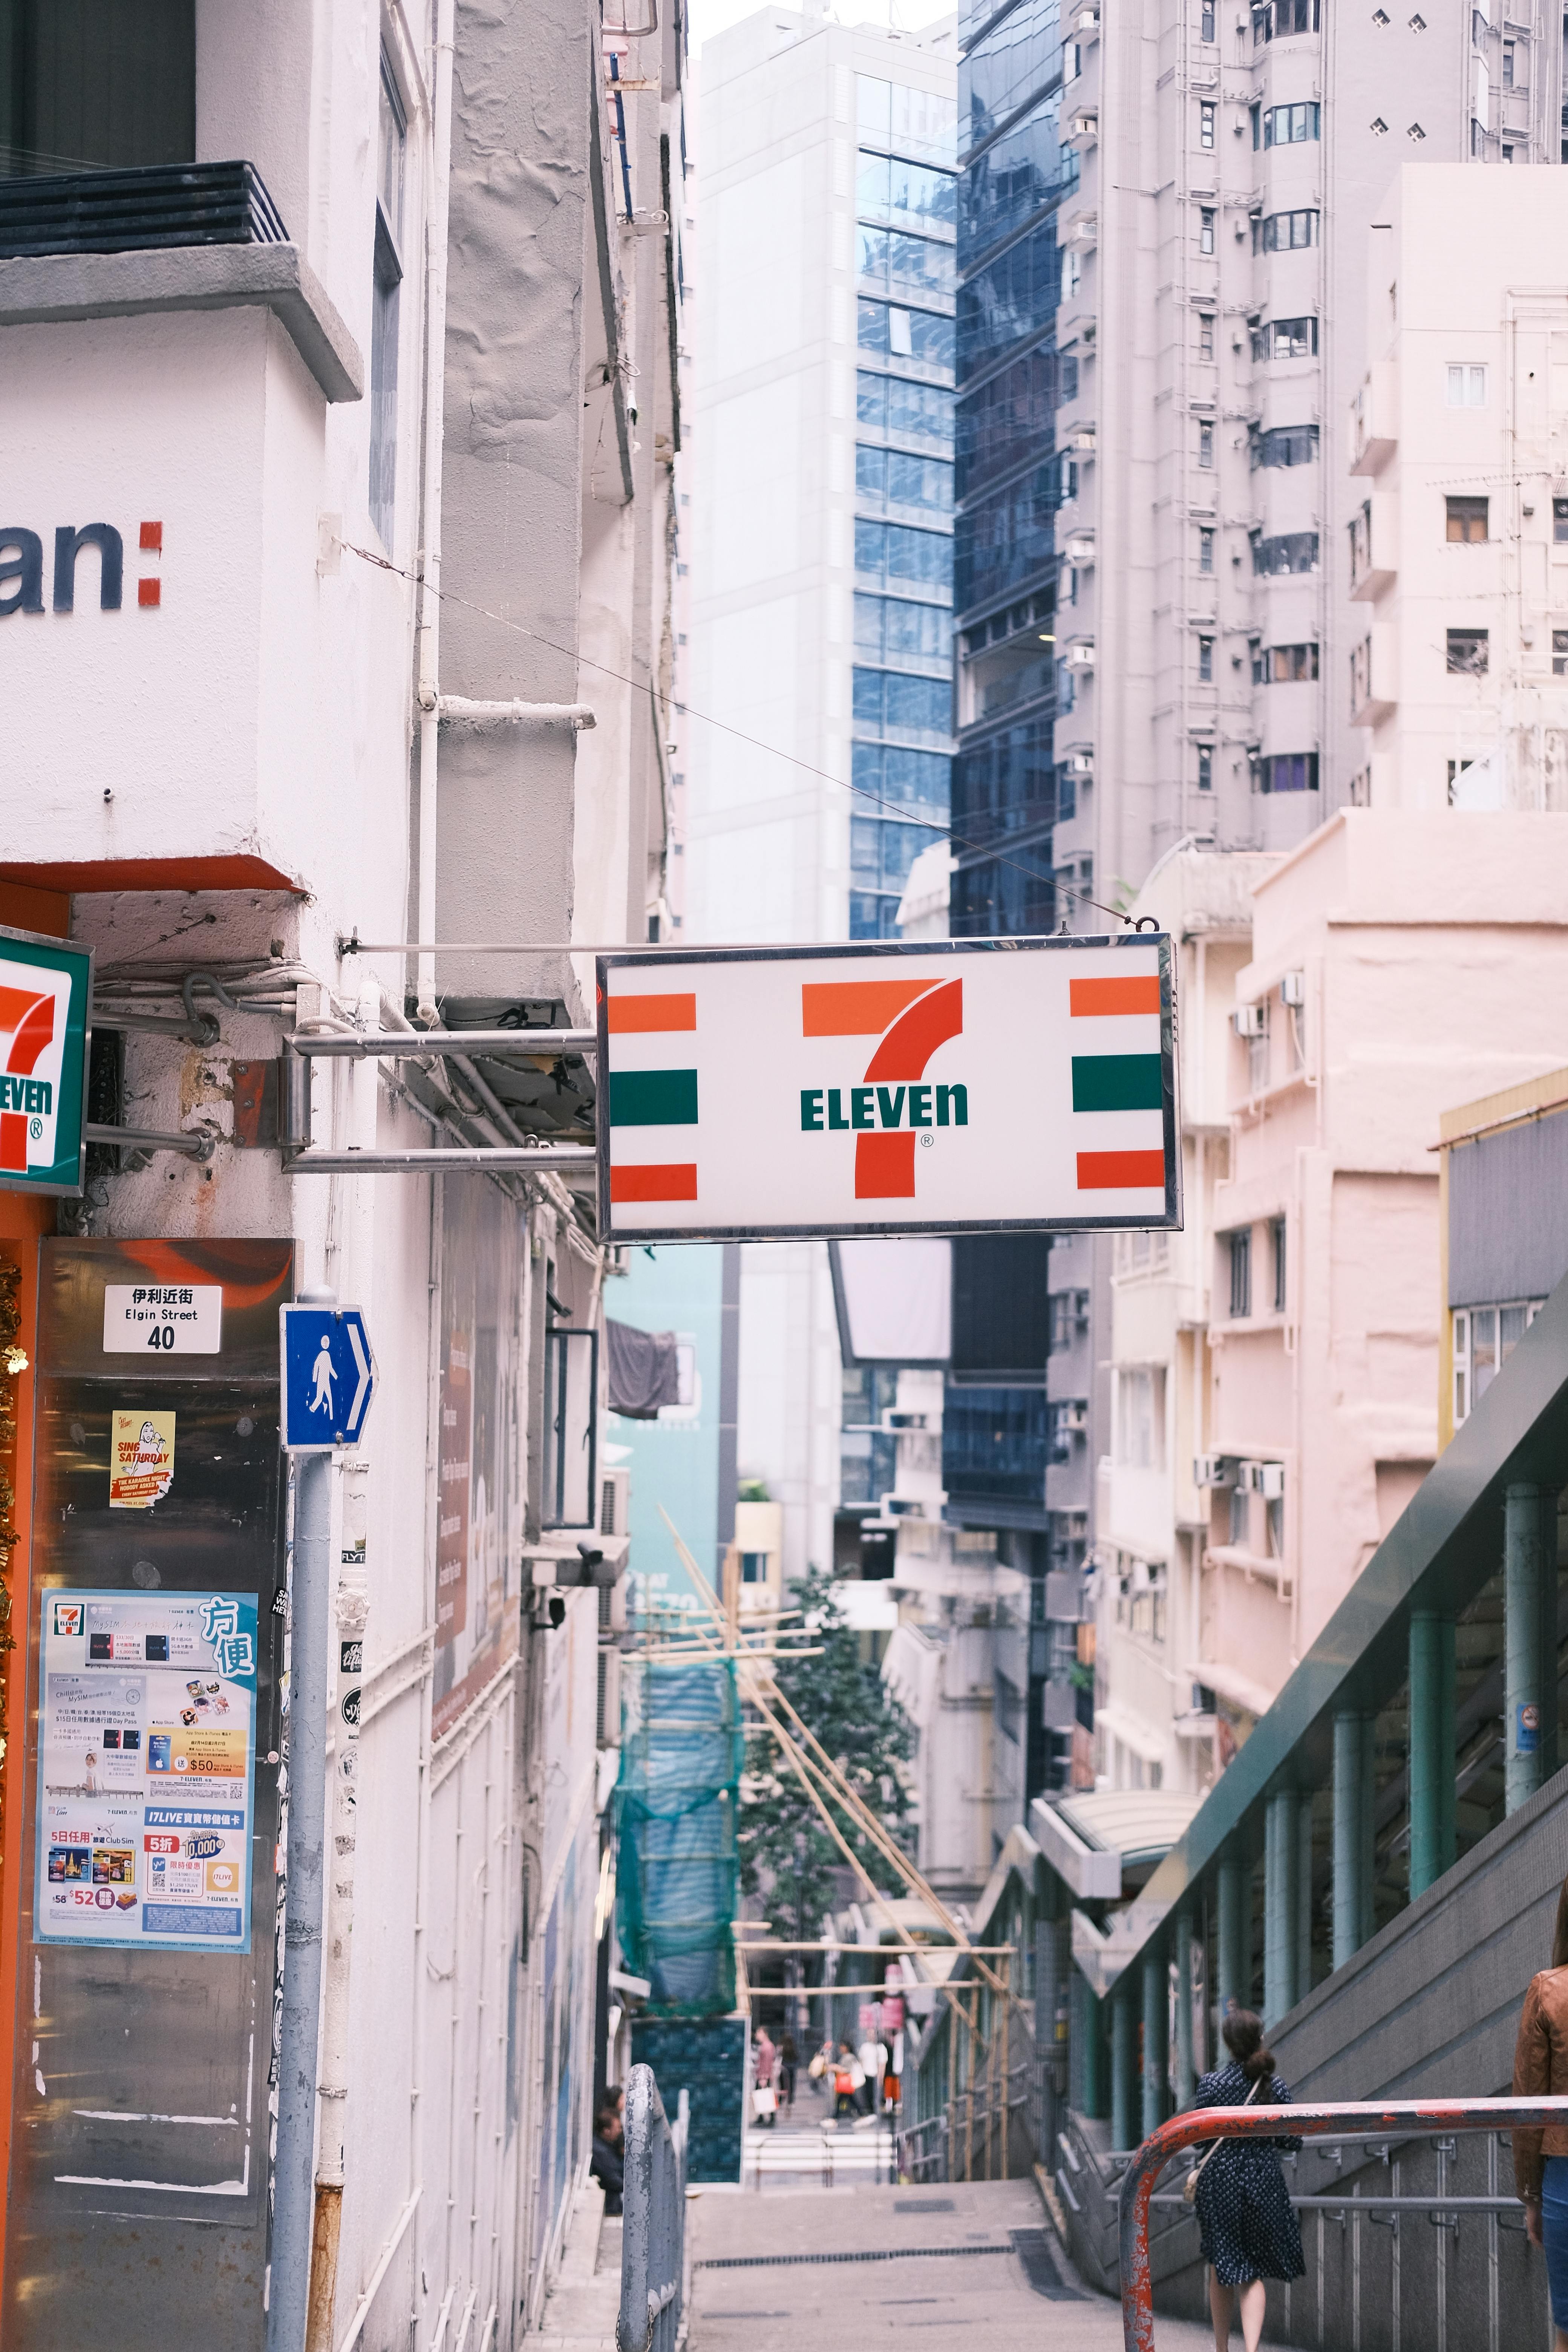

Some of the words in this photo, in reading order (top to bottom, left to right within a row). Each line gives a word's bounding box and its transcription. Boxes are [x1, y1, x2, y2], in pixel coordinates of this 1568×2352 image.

[132, 1288, 193, 1304] 伊利近街
[126, 1309, 156, 1320] Elgin
[161, 1309, 198, 1320] Street
[147, 1326, 175, 1349] 40
[118, 1442, 140, 1452] SING
[119, 1453, 170, 1463] SATURDAY
[202, 1600, 252, 1674] 方便
[178, 1759, 185, 1768] 送
[190, 1759, 213, 1771] $50
[150, 1837, 173, 1852] 5折
[182, 1839, 216, 1857] 10,000
[170, 1861, 200, 1870] 限時優惠
[69, 1890, 94, 1905] $52
